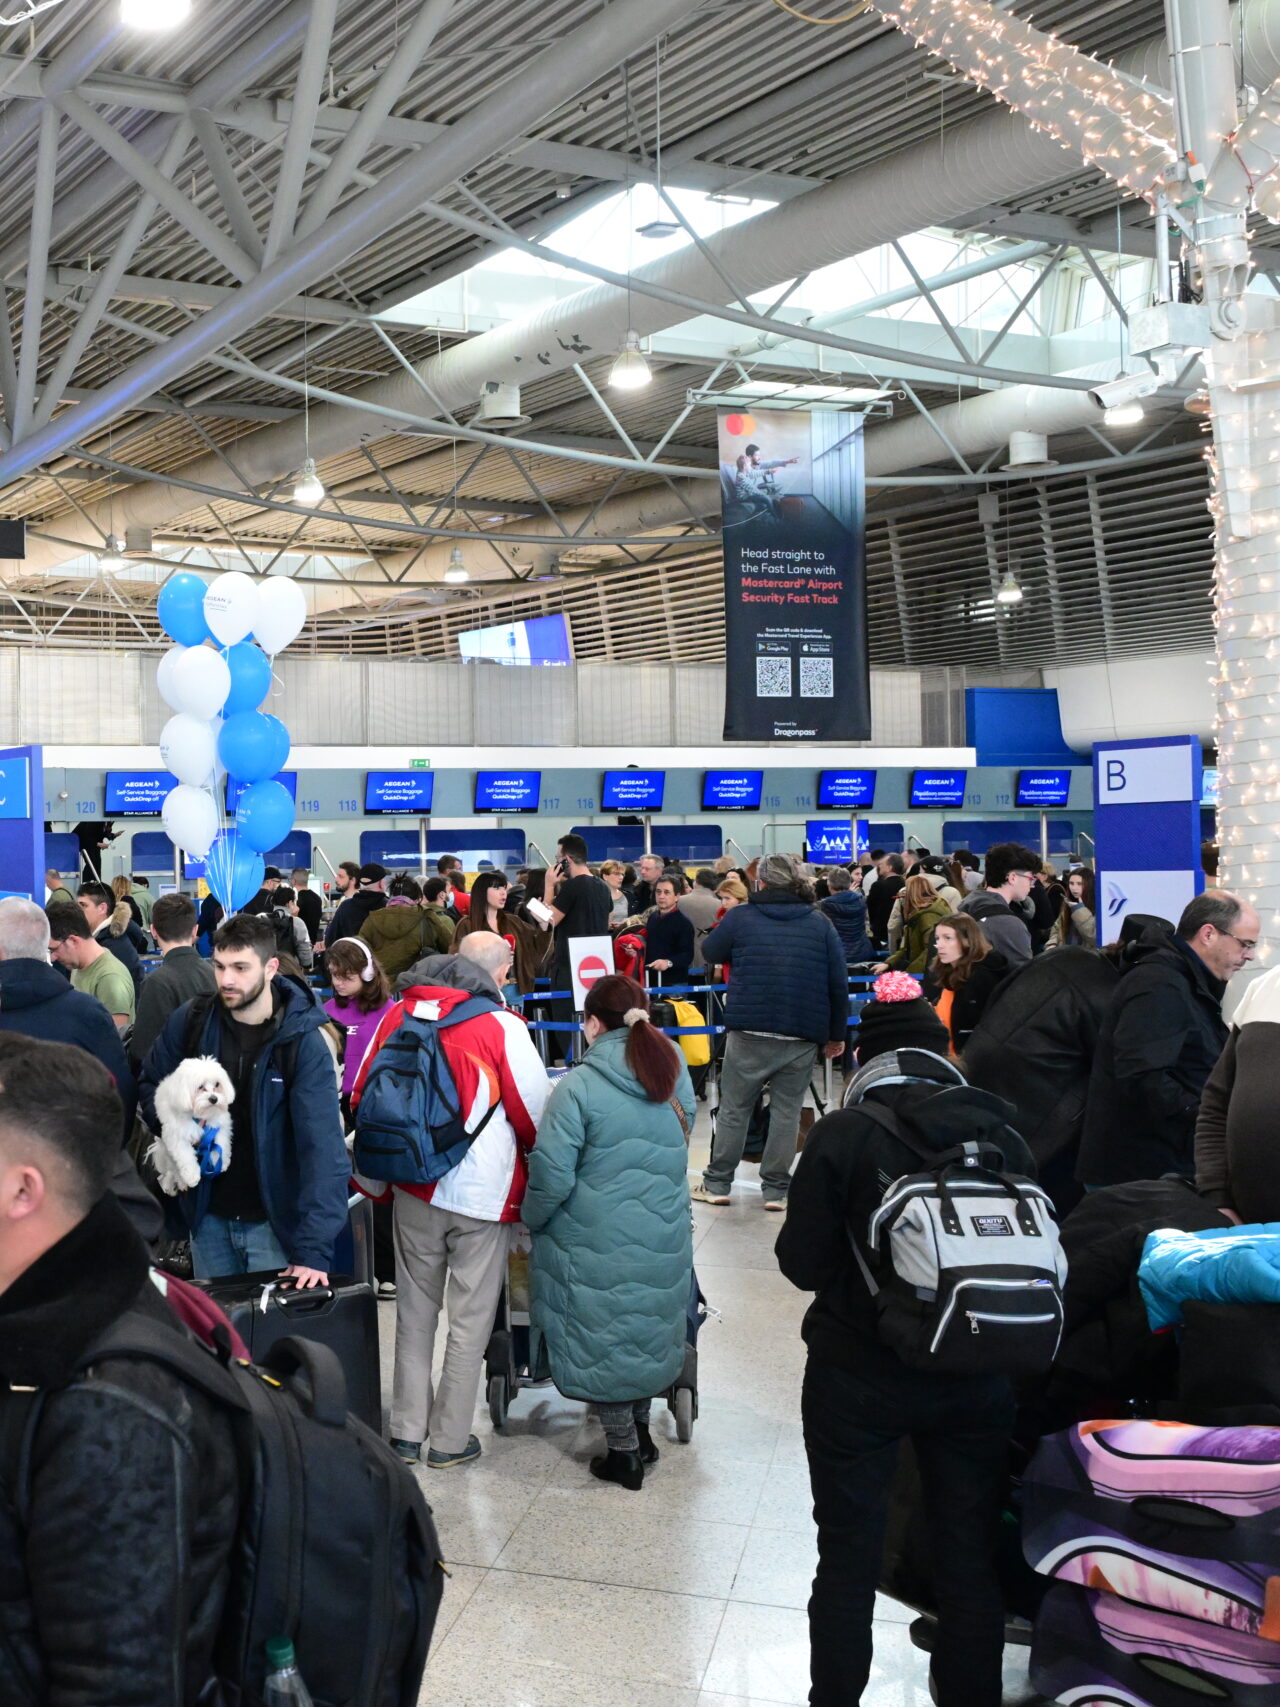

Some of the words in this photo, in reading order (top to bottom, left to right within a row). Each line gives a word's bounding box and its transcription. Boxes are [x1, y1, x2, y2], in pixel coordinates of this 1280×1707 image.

[741, 547, 769, 559] Head
[771, 550, 812, 562] straight
[814, 551, 825, 560] to
[741, 563, 759, 573] the
[761, 563, 785, 574] Fast
[787, 564, 812, 574] Lane
[814, 564, 836, 575] with
[807, 579, 843, 592] Airport
[741, 592, 785, 605] Security
[787, 593, 810, 604] Fast
[811, 594, 839, 604] Track
[774, 728, 816, 737] Dragonpass
[1107, 760, 1127, 792] B
[76, 801, 96, 814] 120
[301, 801, 319, 812] 119
[339, 801, 357, 811] 118
